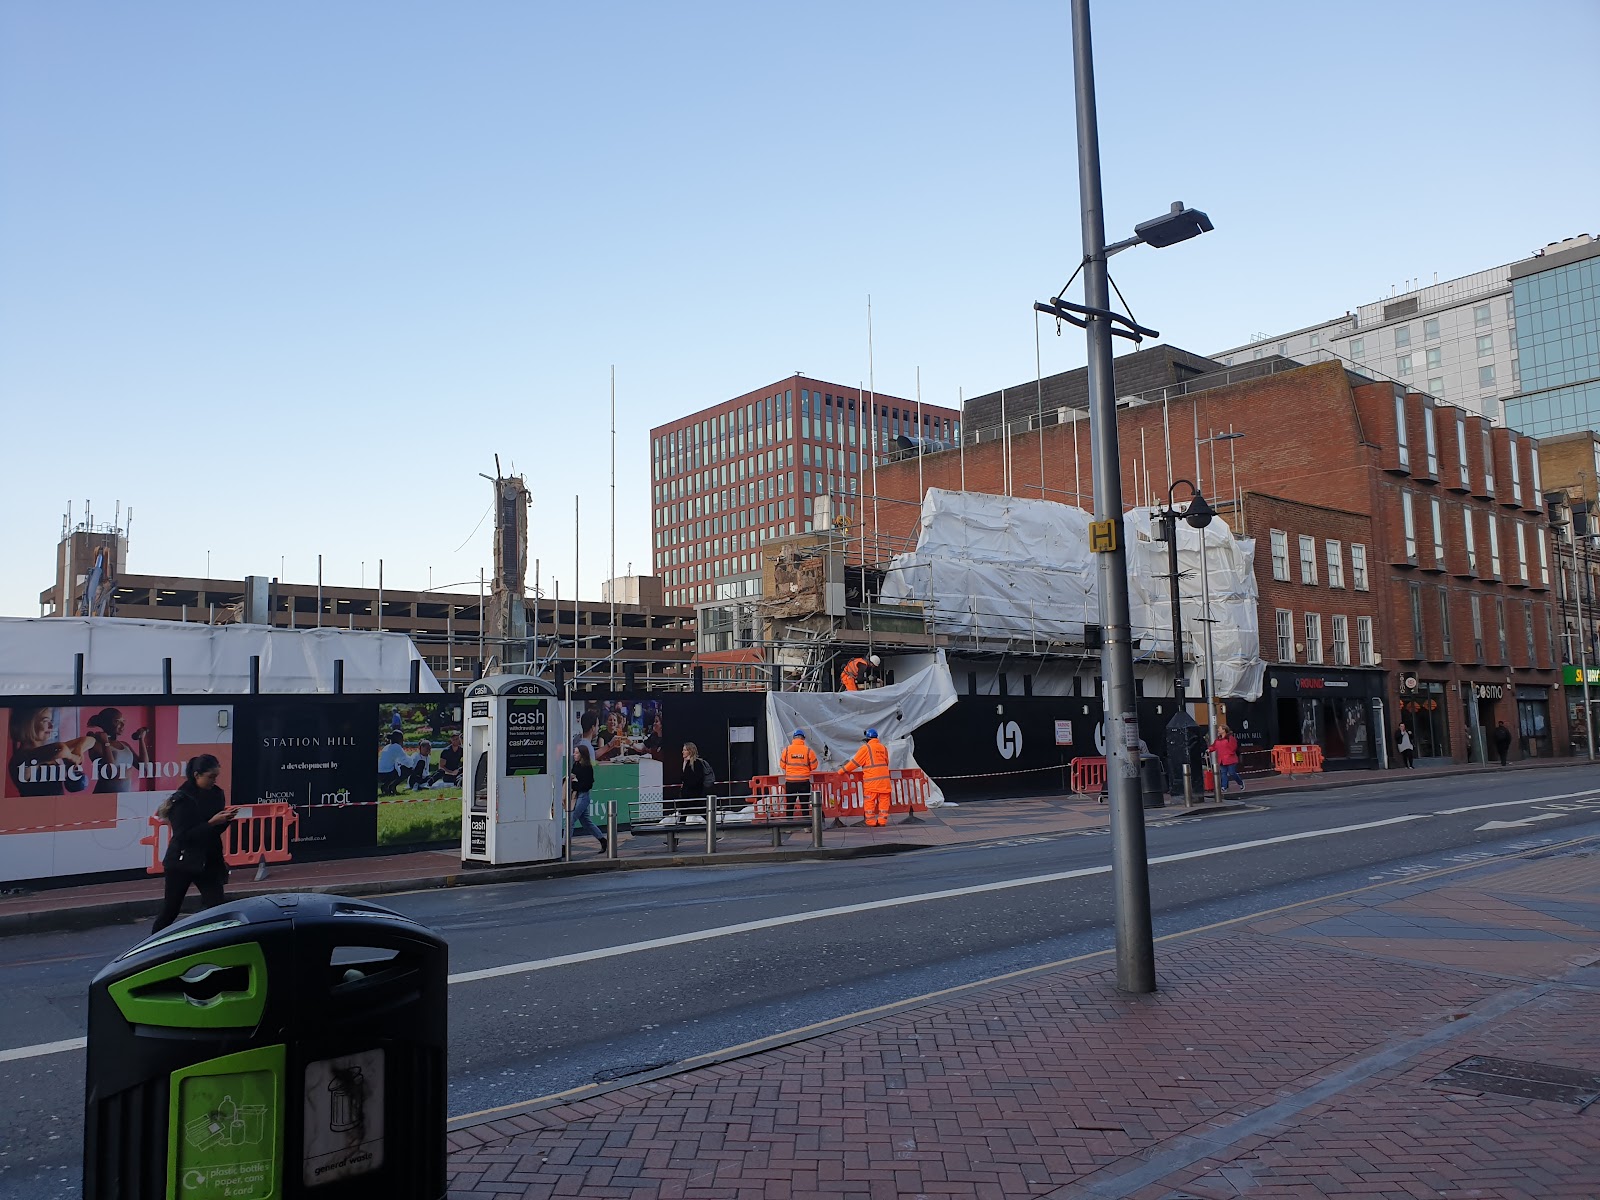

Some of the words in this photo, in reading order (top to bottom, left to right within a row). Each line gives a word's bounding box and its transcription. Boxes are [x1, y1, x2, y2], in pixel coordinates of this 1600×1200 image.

[1093, 522, 1112, 549] H
[1576, 669, 1600, 682] SUWAY
[475, 685, 488, 695] cash
[517, 685, 539, 694] cash
[508, 709, 545, 724] cash
[263, 737, 320, 747] STATION
[327, 736, 356, 746] HILL
[17, 758, 83, 783] time
[91, 757, 132, 781] for
[286, 762, 329, 771] development
[331, 761, 338, 770] by
[265, 791, 294, 799] LINCOLN
[471, 819, 486, 830] cash
[314, 1158, 347, 1176] general
[349, 1151, 373, 1164] waste
[210, 1165, 238, 1179] plastic
[239, 1163, 269, 1175] bottles
[214, 1176, 243, 1188] paper,
[244, 1173, 264, 1184] cans
[223, 1187, 232, 1197] &
[232, 1184, 254, 1196] card
